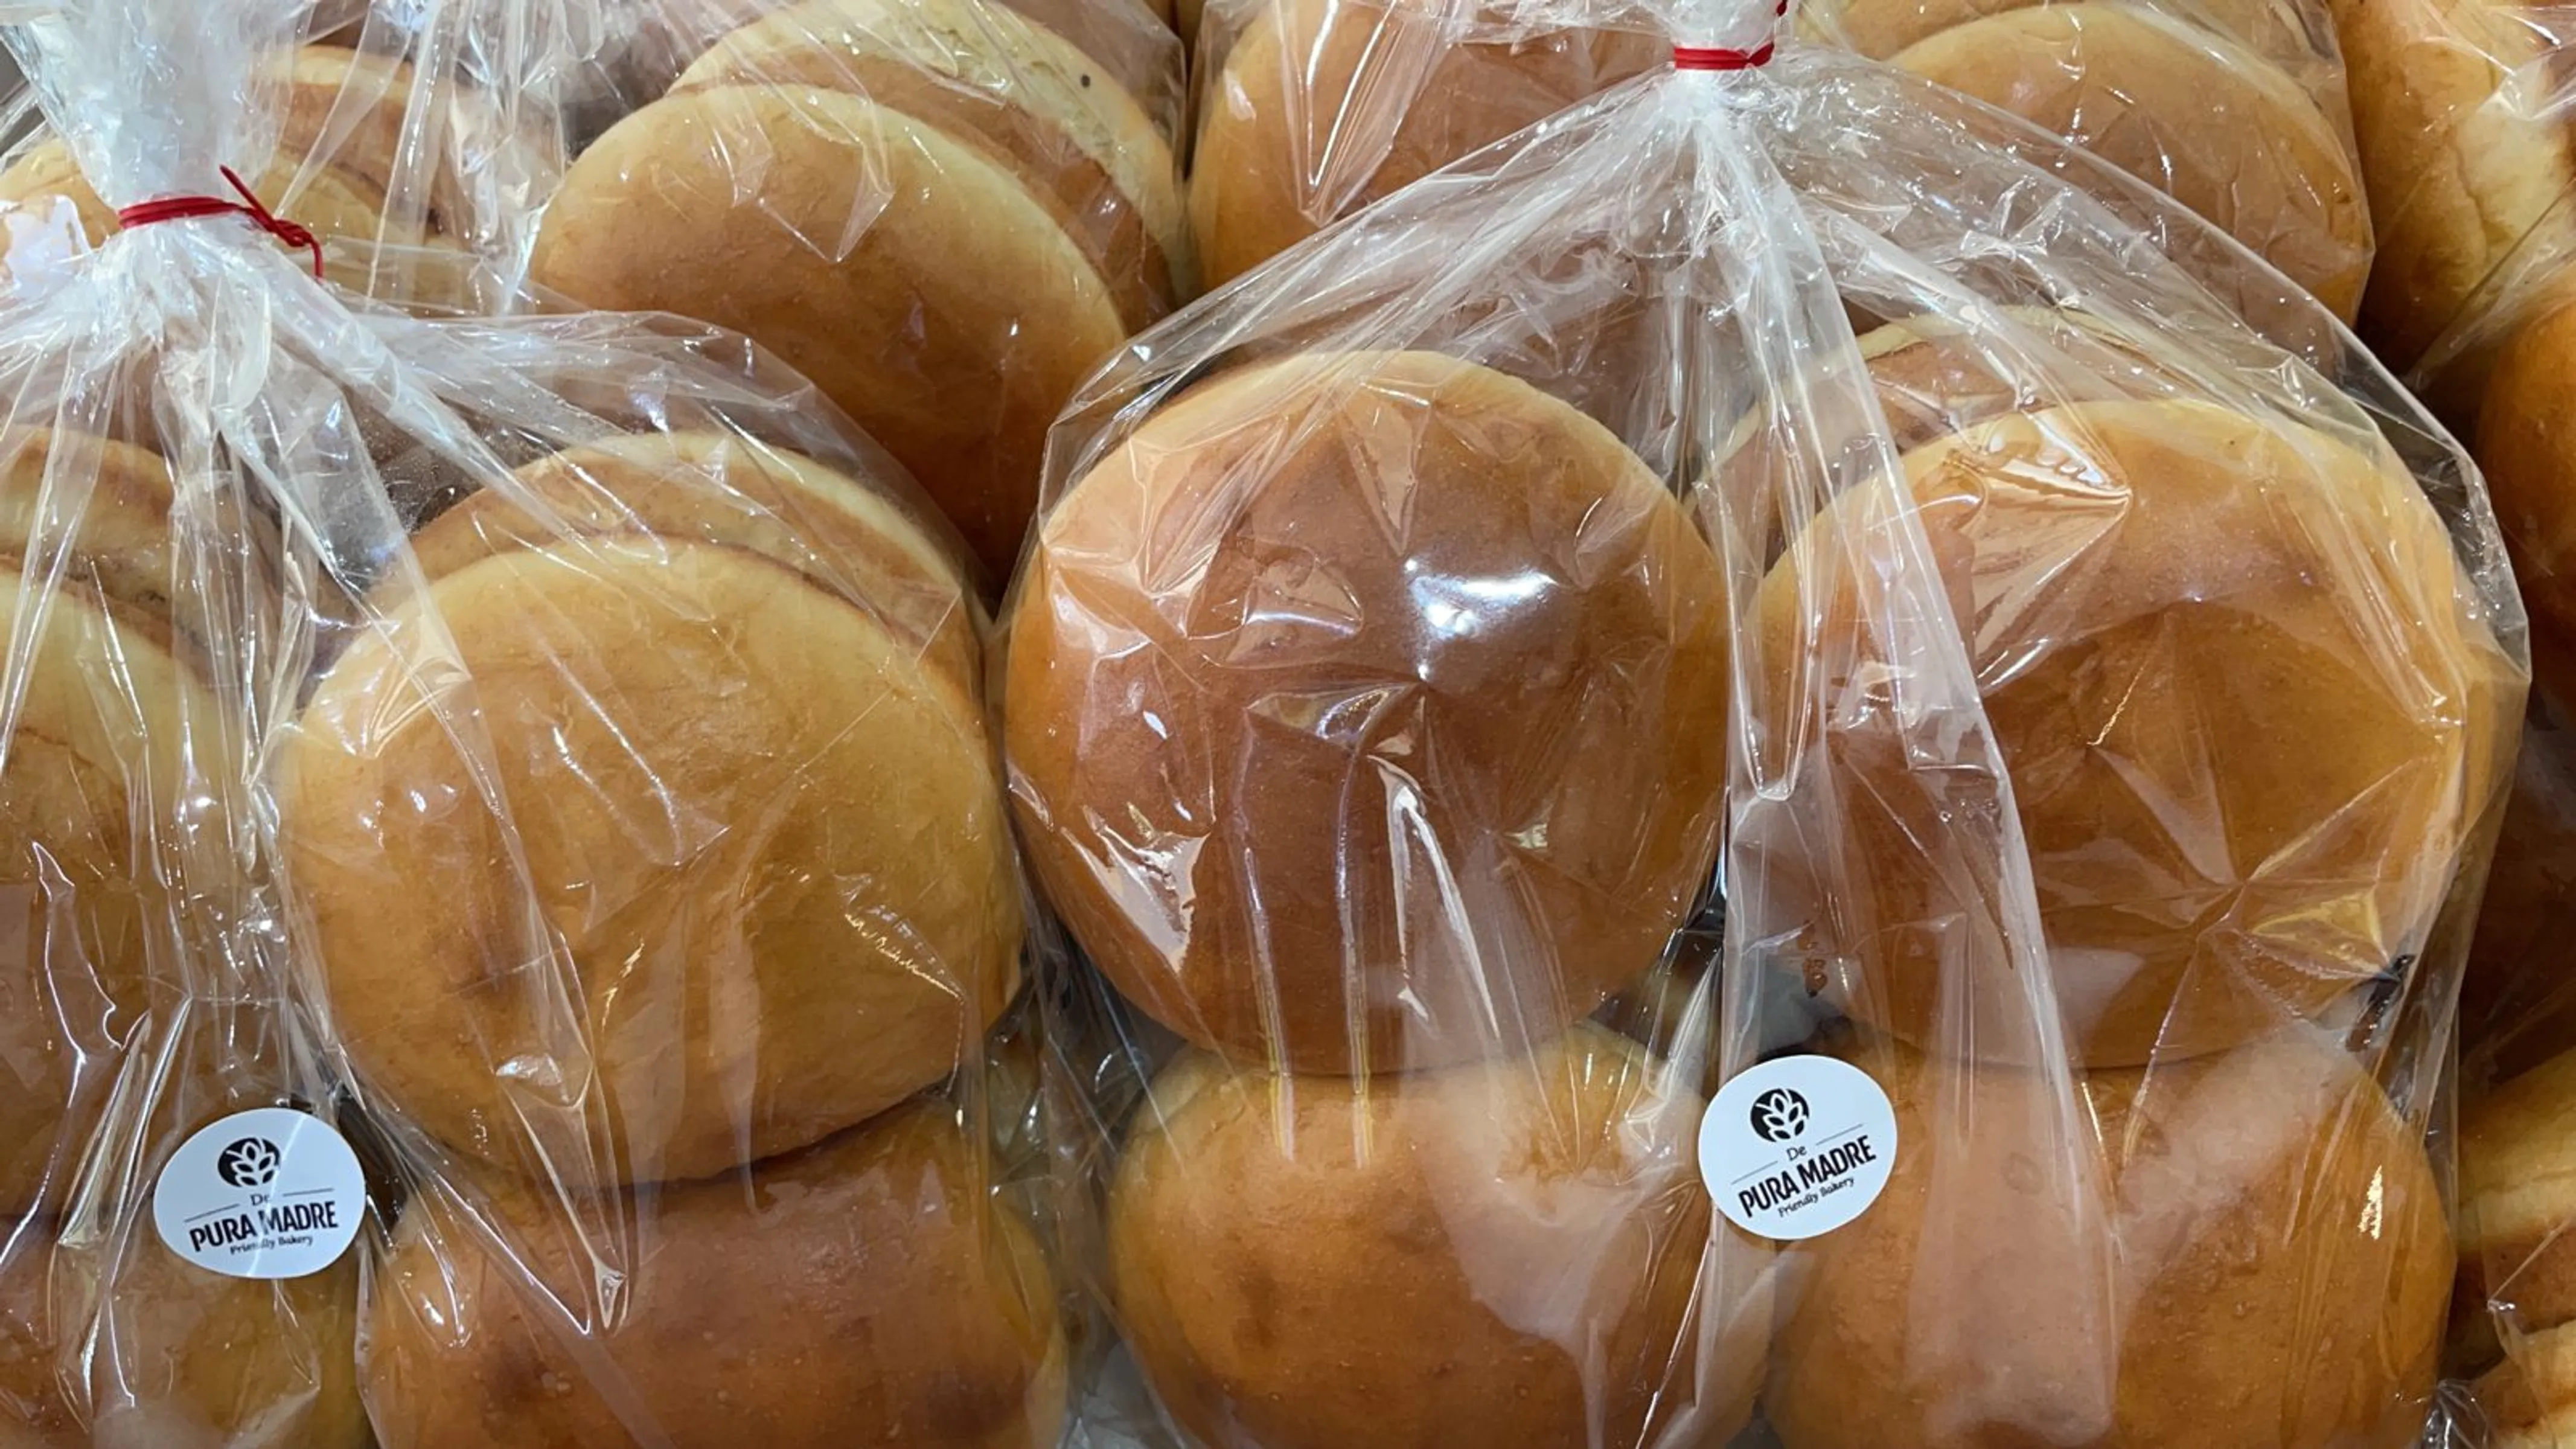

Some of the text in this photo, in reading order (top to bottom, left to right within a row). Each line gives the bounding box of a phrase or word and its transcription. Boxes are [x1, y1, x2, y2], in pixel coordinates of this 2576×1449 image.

[1786, 1146, 1806, 1162] De
[1739, 1135, 1876, 1218] PURA MADRE
[1777, 1177, 1854, 1217] Friendly Bakery
[190, 1201, 338, 1252] PURA MADRE
[278, 1235, 313, 1248] Bakery
